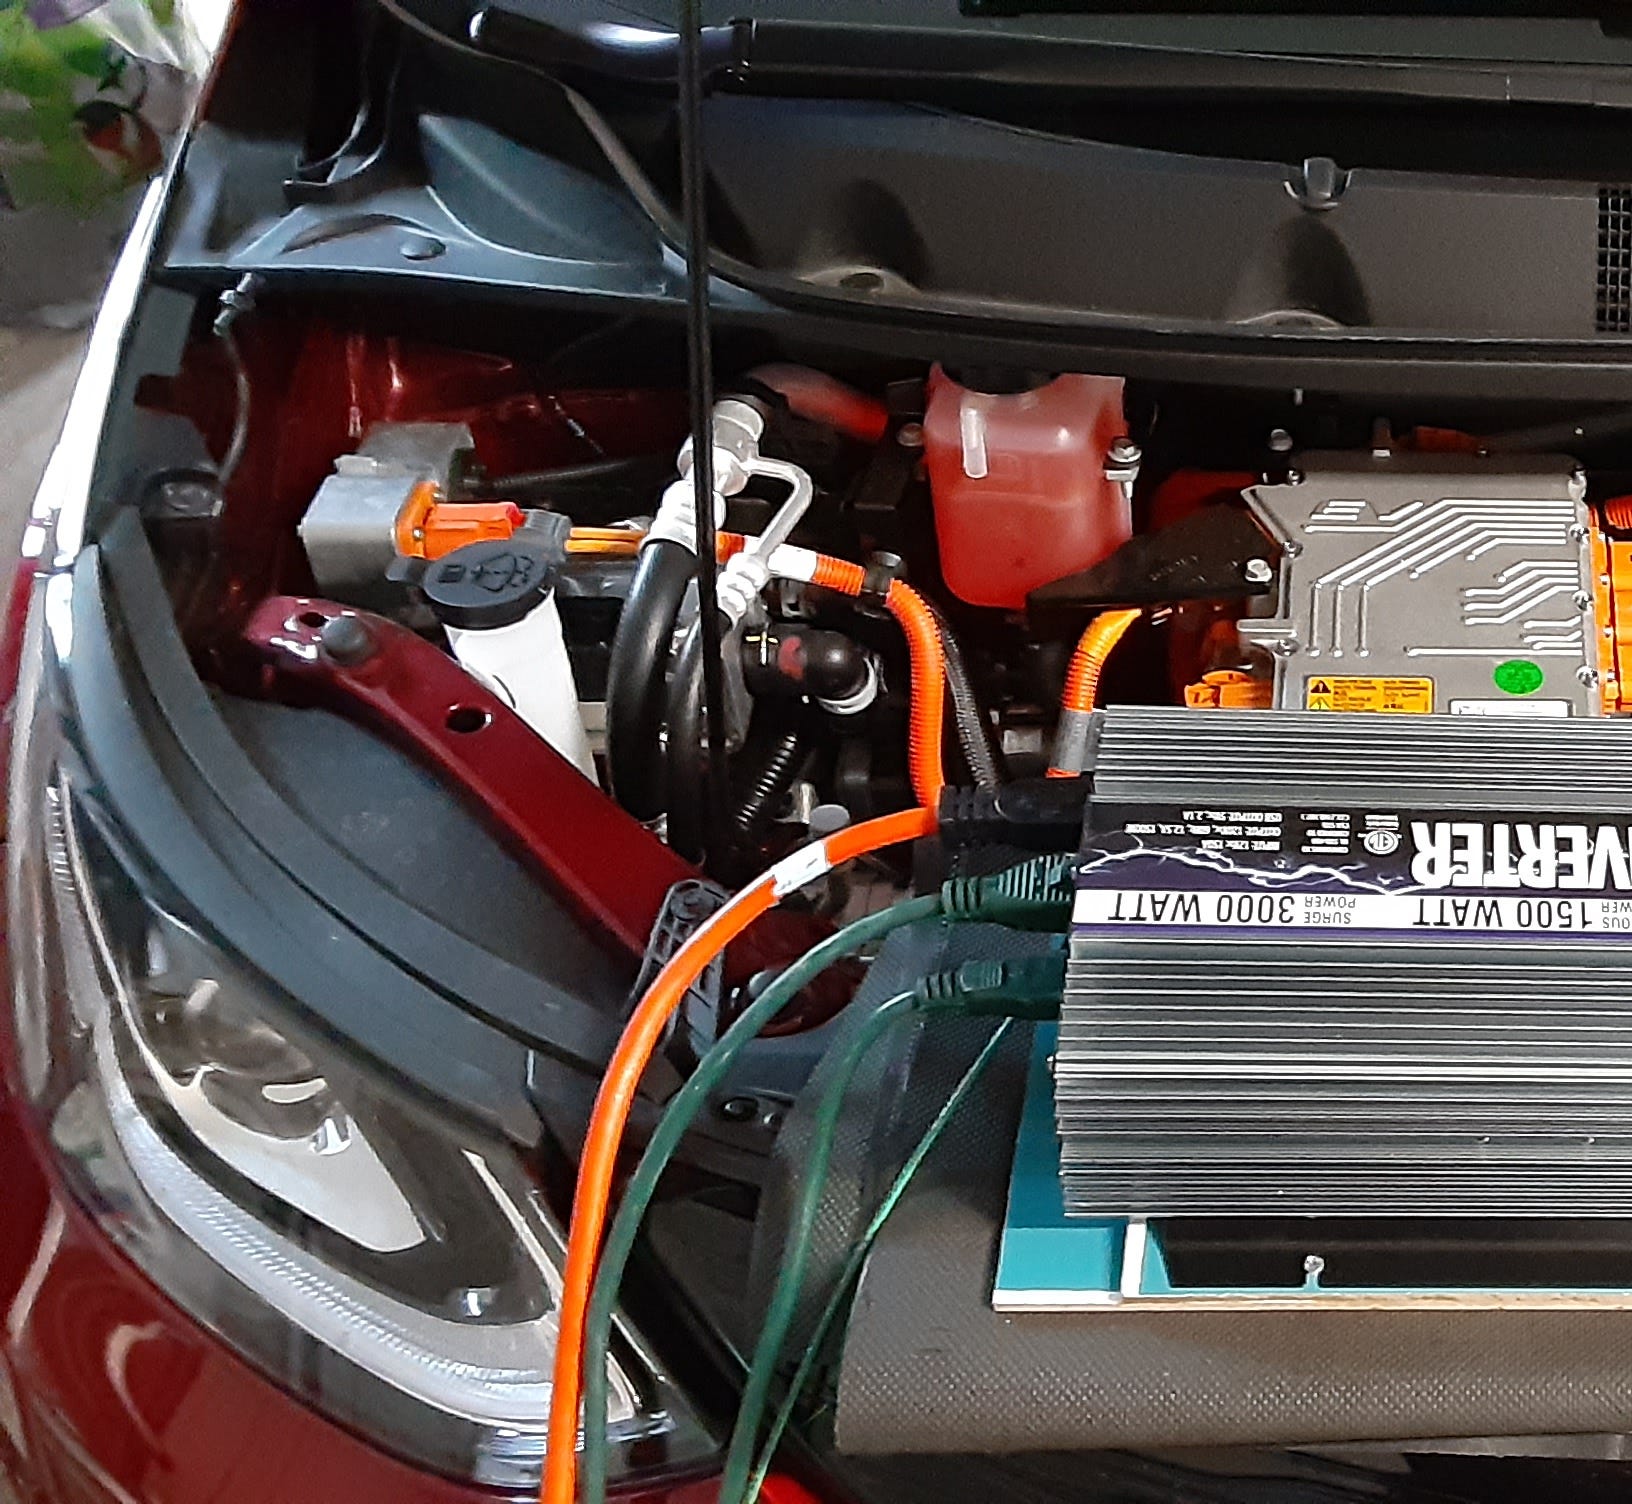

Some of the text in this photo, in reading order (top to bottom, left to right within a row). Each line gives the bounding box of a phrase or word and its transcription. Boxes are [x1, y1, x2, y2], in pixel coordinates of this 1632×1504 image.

[1106, 892, 1295, 924] 3000 WATT
[1303, 895, 1357, 909] POWER
[1412, 897, 1593, 929] 1500 WATT
[1303, 911, 1352, 925] SURGE
